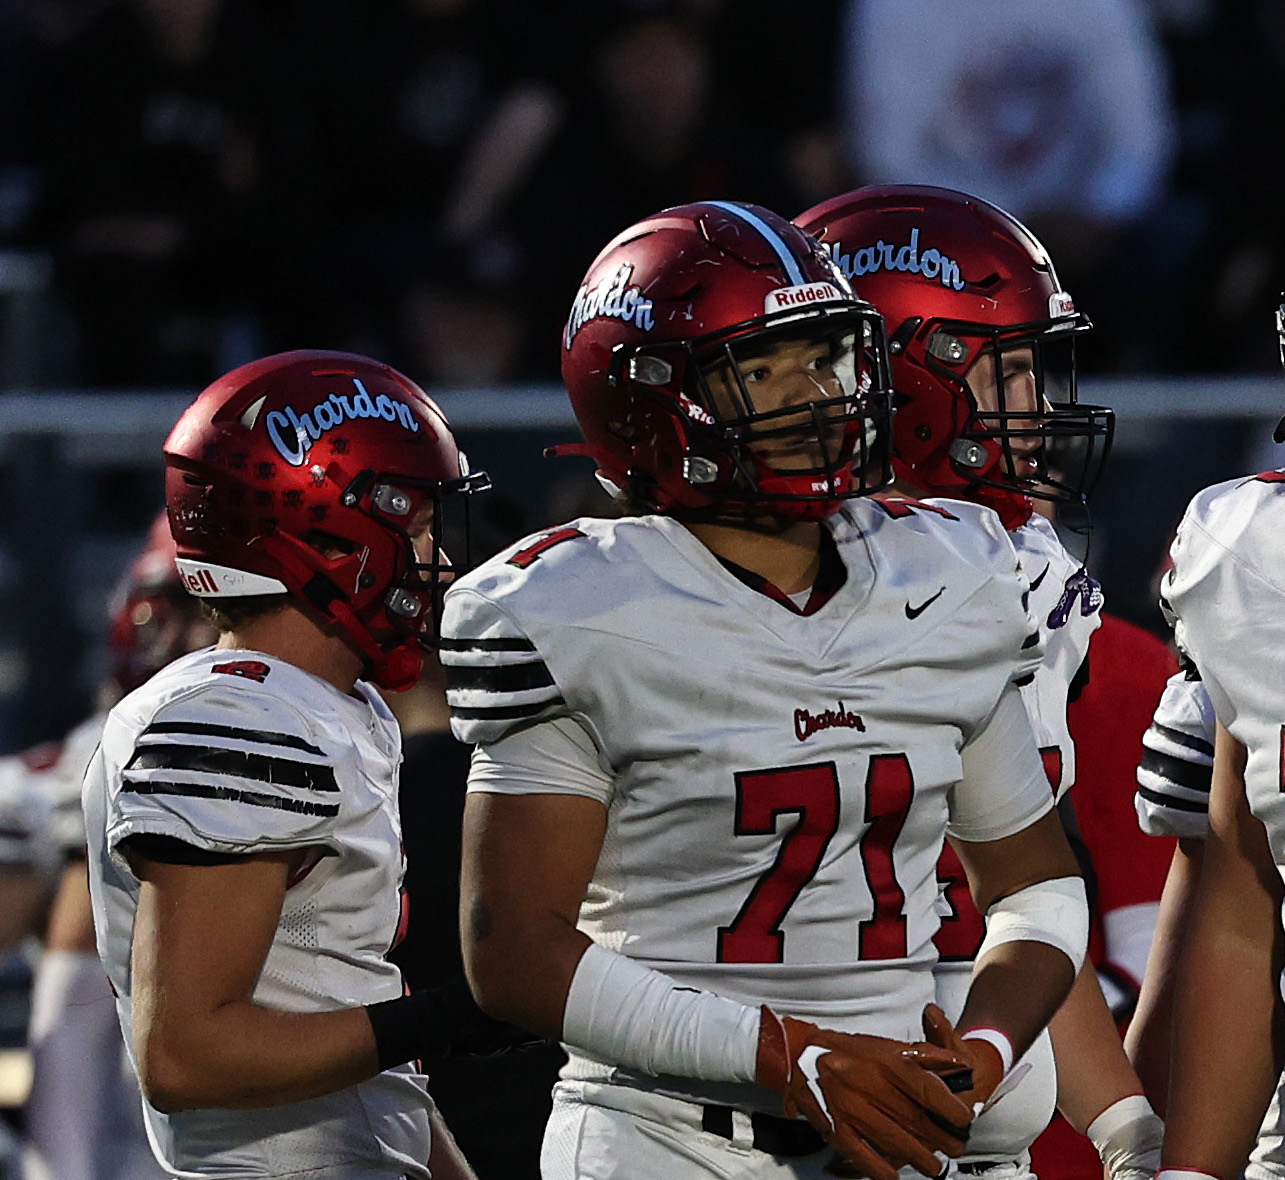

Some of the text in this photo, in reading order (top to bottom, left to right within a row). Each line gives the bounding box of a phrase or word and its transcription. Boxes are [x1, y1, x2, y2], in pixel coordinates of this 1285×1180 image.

[774, 286, 836, 309] Riddell
[266, 377, 421, 467] Chardon
[793, 700, 866, 742] Chardon
[715, 751, 915, 964] 71
